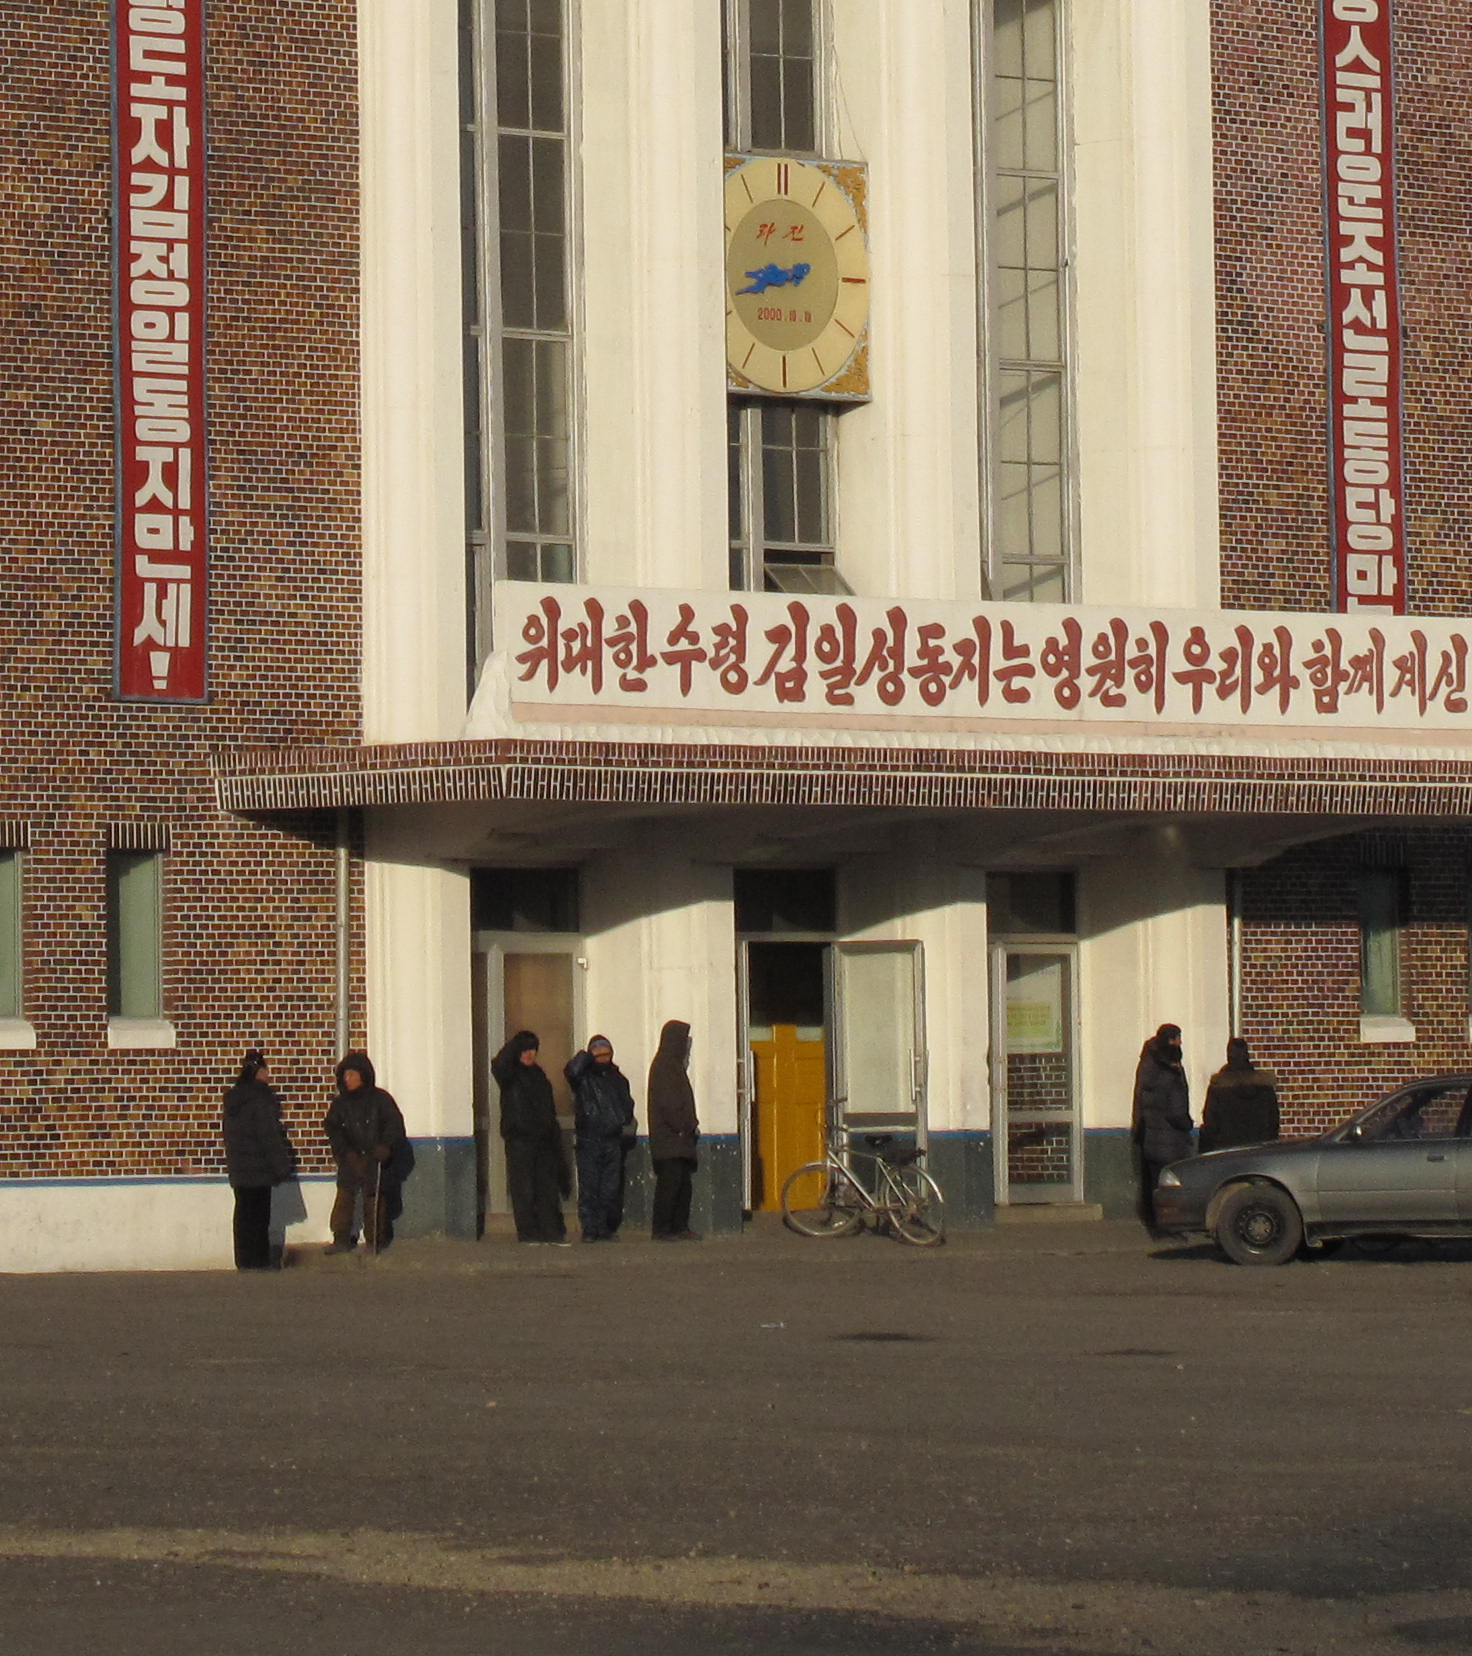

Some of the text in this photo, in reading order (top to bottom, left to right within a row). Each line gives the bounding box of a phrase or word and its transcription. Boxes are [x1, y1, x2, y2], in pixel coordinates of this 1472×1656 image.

[133, 513, 195, 690] 만세!
[516, 595, 656, 693] 위대한
[660, 601, 749, 698] 수령
[1039, 616, 1169, 714] 영원히
[1172, 624, 1300, 715] 우리와
[1301, 626, 1387, 715] 함께
